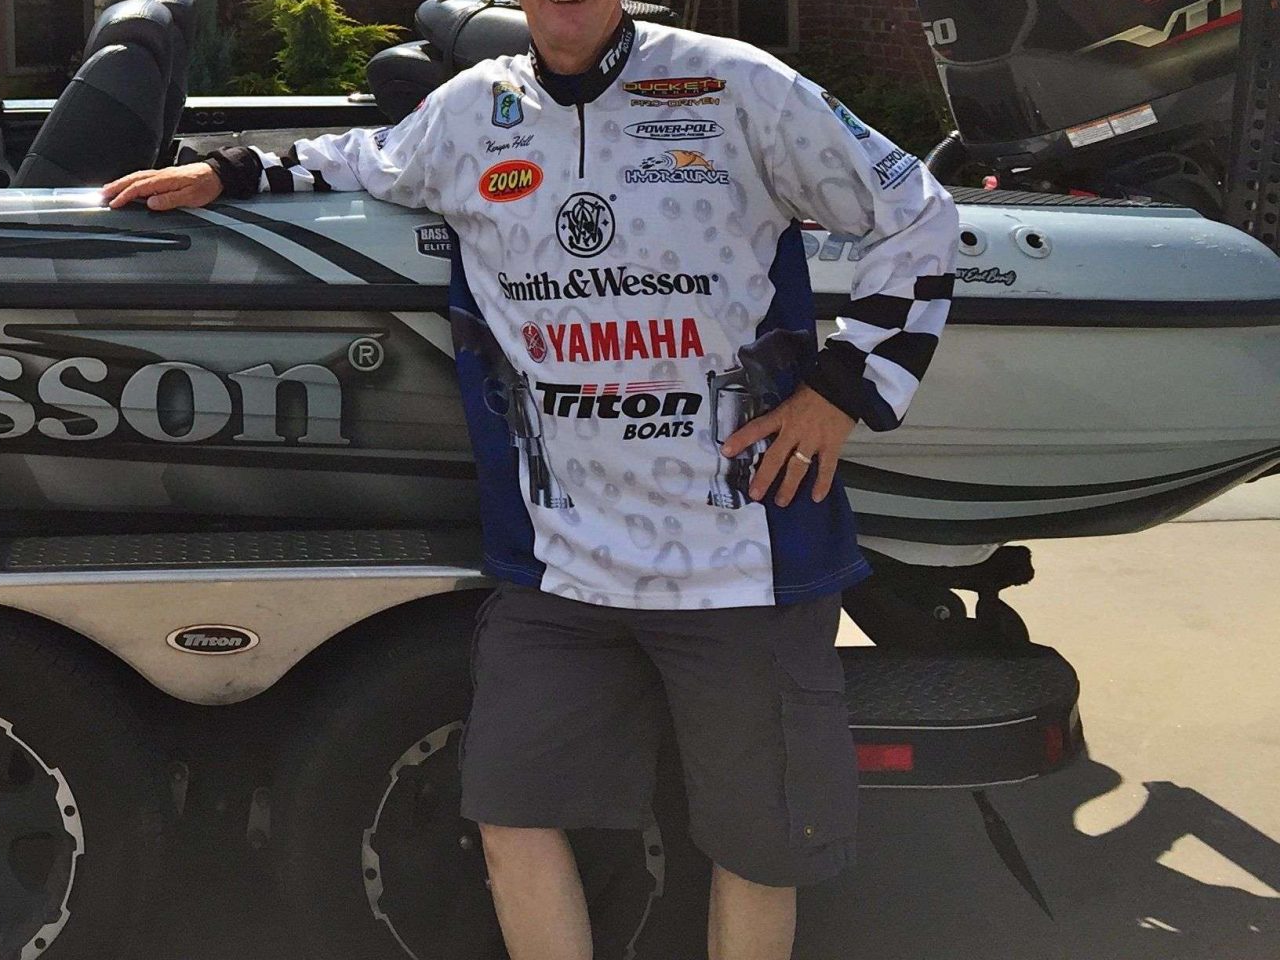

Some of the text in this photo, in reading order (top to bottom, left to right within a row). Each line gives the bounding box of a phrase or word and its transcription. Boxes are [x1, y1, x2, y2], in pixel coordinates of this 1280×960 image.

[623, 79, 726, 92] DUCKETT
[635, 123, 717, 134] POWER-POLE
[872, 148, 911, 186] NICHOL
[488, 169, 533, 192] ZOOM
[625, 169, 730, 185] HYDROWAVE
[420, 227, 449, 241] BASS
[423, 243, 452, 251] ELITE
[498, 266, 713, 301] Smith&Wesson
[546, 317, 705, 363] YAMAHA
[535, 380, 704, 419] Triton
[622, 420, 695, 441] BOATS
[183, 632, 243, 648] Triton
